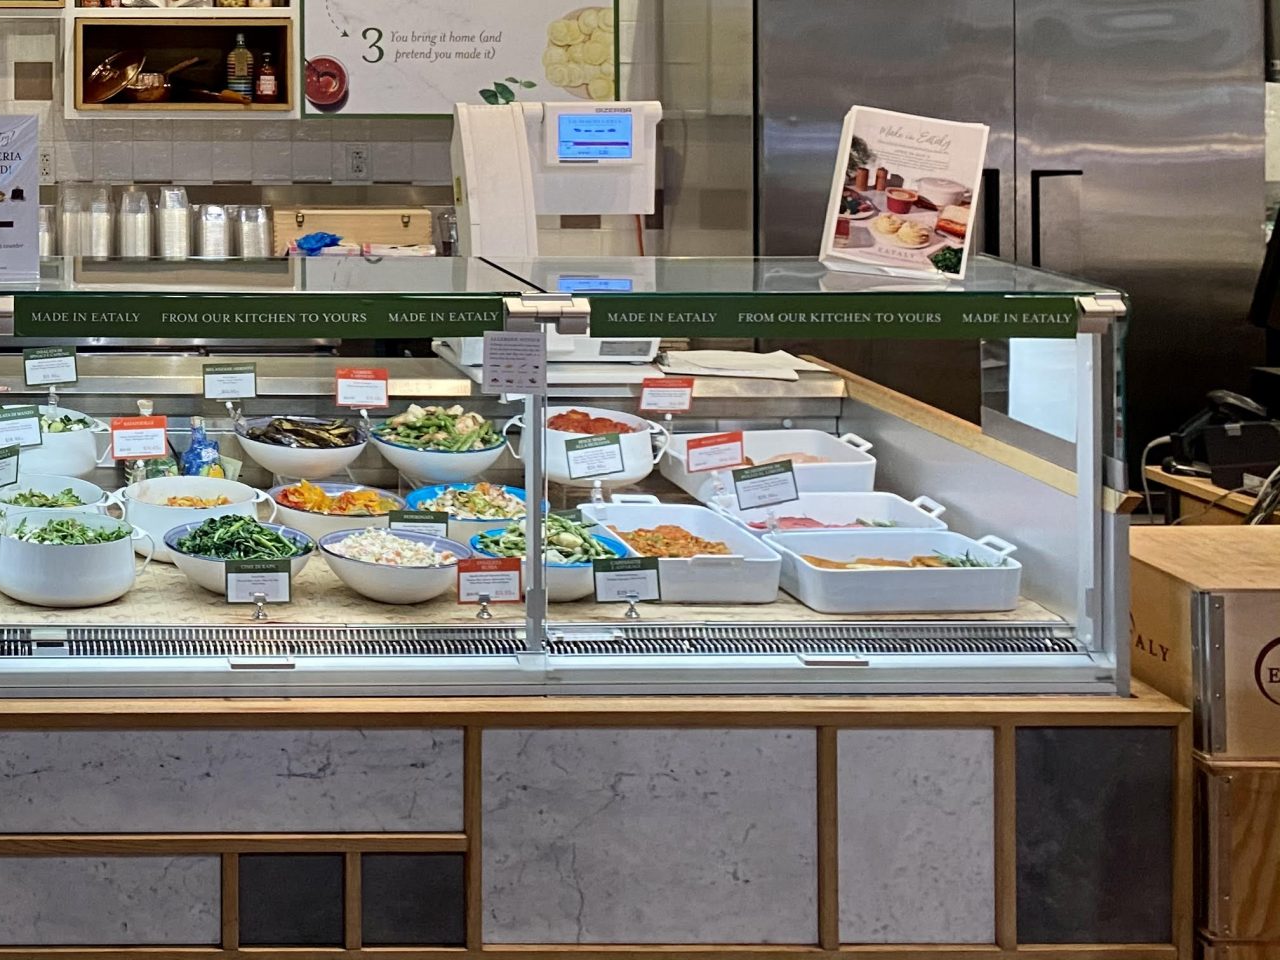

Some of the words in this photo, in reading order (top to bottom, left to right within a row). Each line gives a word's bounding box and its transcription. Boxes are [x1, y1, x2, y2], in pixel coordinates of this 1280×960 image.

[390, 31, 408, 43] You
[411, 31, 438, 46] bring
[439, 31, 447, 43] it
[448, 31, 476, 43] home
[479, 30, 502, 43] (and
[361, 27, 384, 63] 3
[394, 48, 432, 62] pretend
[430, 51, 452, 63] you
[454, 48, 481, 59] made
[483, 46, 496, 60] it)
[31, 312, 69, 322] MADE
[73, 312, 87, 322] IN
[91, 312, 140, 322] EATALY
[161, 313, 198, 323] FROM
[201, 313, 231, 323] OUR
[234, 313, 296, 323] KITCHEN
[299, 312, 320, 323] TO
[322, 312, 368, 323] YOURS
[388, 312, 427, 323] MADE
[430, 312, 445, 322] IN
[449, 311, 500, 323] EATALY
[607, 312, 646, 323] MADE
[649, 312, 664, 323] IN
[667, 312, 718, 323] EATALY
[738, 312, 775, 323] FROM
[777, 312, 807, 323] OUR
[810, 312, 871, 323] KITCHEN
[874, 312, 894, 323] TO
[896, 312, 942, 323] YOURS
[962, 313, 1000, 323] MADE
[1003, 313, 1018, 323] IN
[1022, 313, 1072, 324] EATALY
[1135, 634, 1170, 662] ALY
